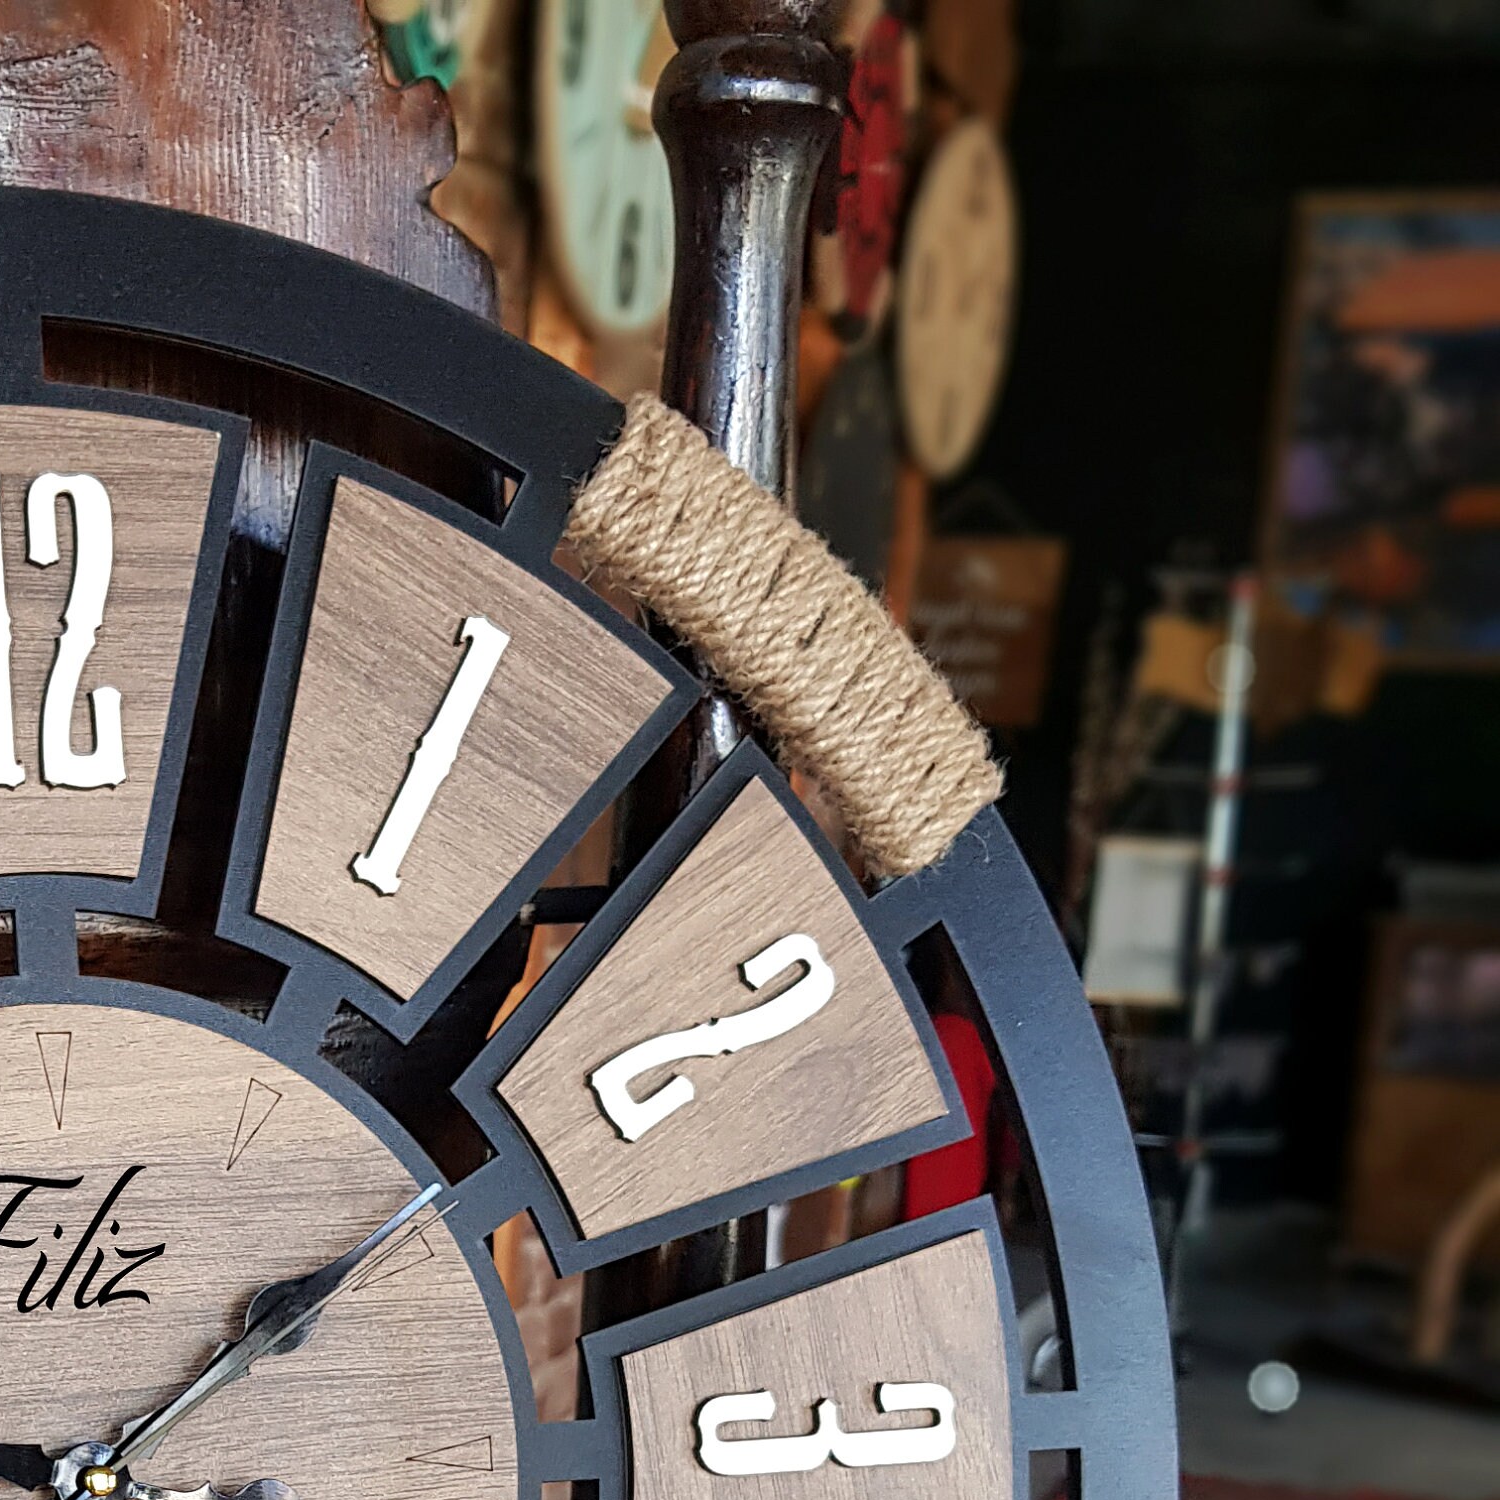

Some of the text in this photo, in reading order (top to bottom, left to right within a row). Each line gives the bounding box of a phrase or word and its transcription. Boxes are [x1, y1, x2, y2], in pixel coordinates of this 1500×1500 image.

[350, 615, 510, 896] 1
[588, 931, 840, 1143] 2
[694, 1380, 958, 1477] 3
